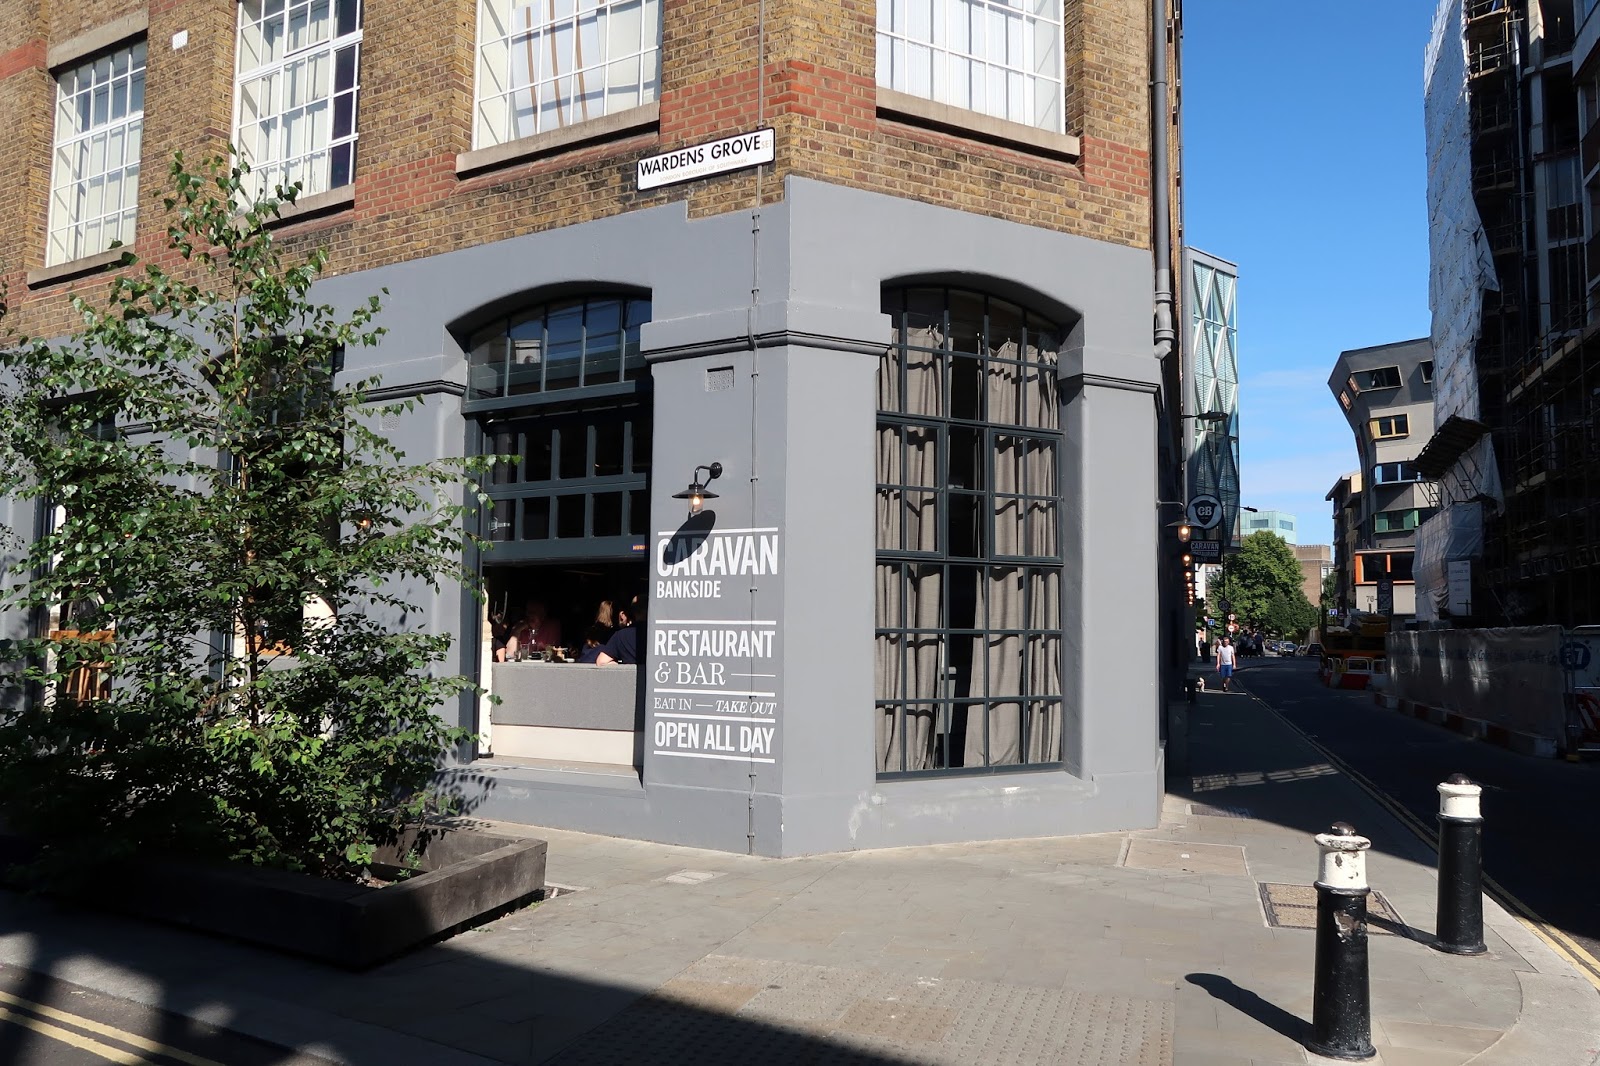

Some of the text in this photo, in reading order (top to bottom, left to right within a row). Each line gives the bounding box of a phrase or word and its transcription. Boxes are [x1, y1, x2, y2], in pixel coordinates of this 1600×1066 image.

[639, 134, 772, 177] WARDENS GROVE SE1
[659, 157, 748, 183] LONDON BOROUGH OF SOUTHWARK
[656, 534, 779, 577] CARAVAN
[1190, 542, 1220, 550] CARAVAN
[656, 580, 722, 599] BANKSIDE
[654, 629, 776, 658] RESTAURANT
[654, 661, 726, 686] & BAR
[653, 697, 777, 715] EAT IN TAKE OUT
[654, 720, 775, 754] OPEN ALL DAY
